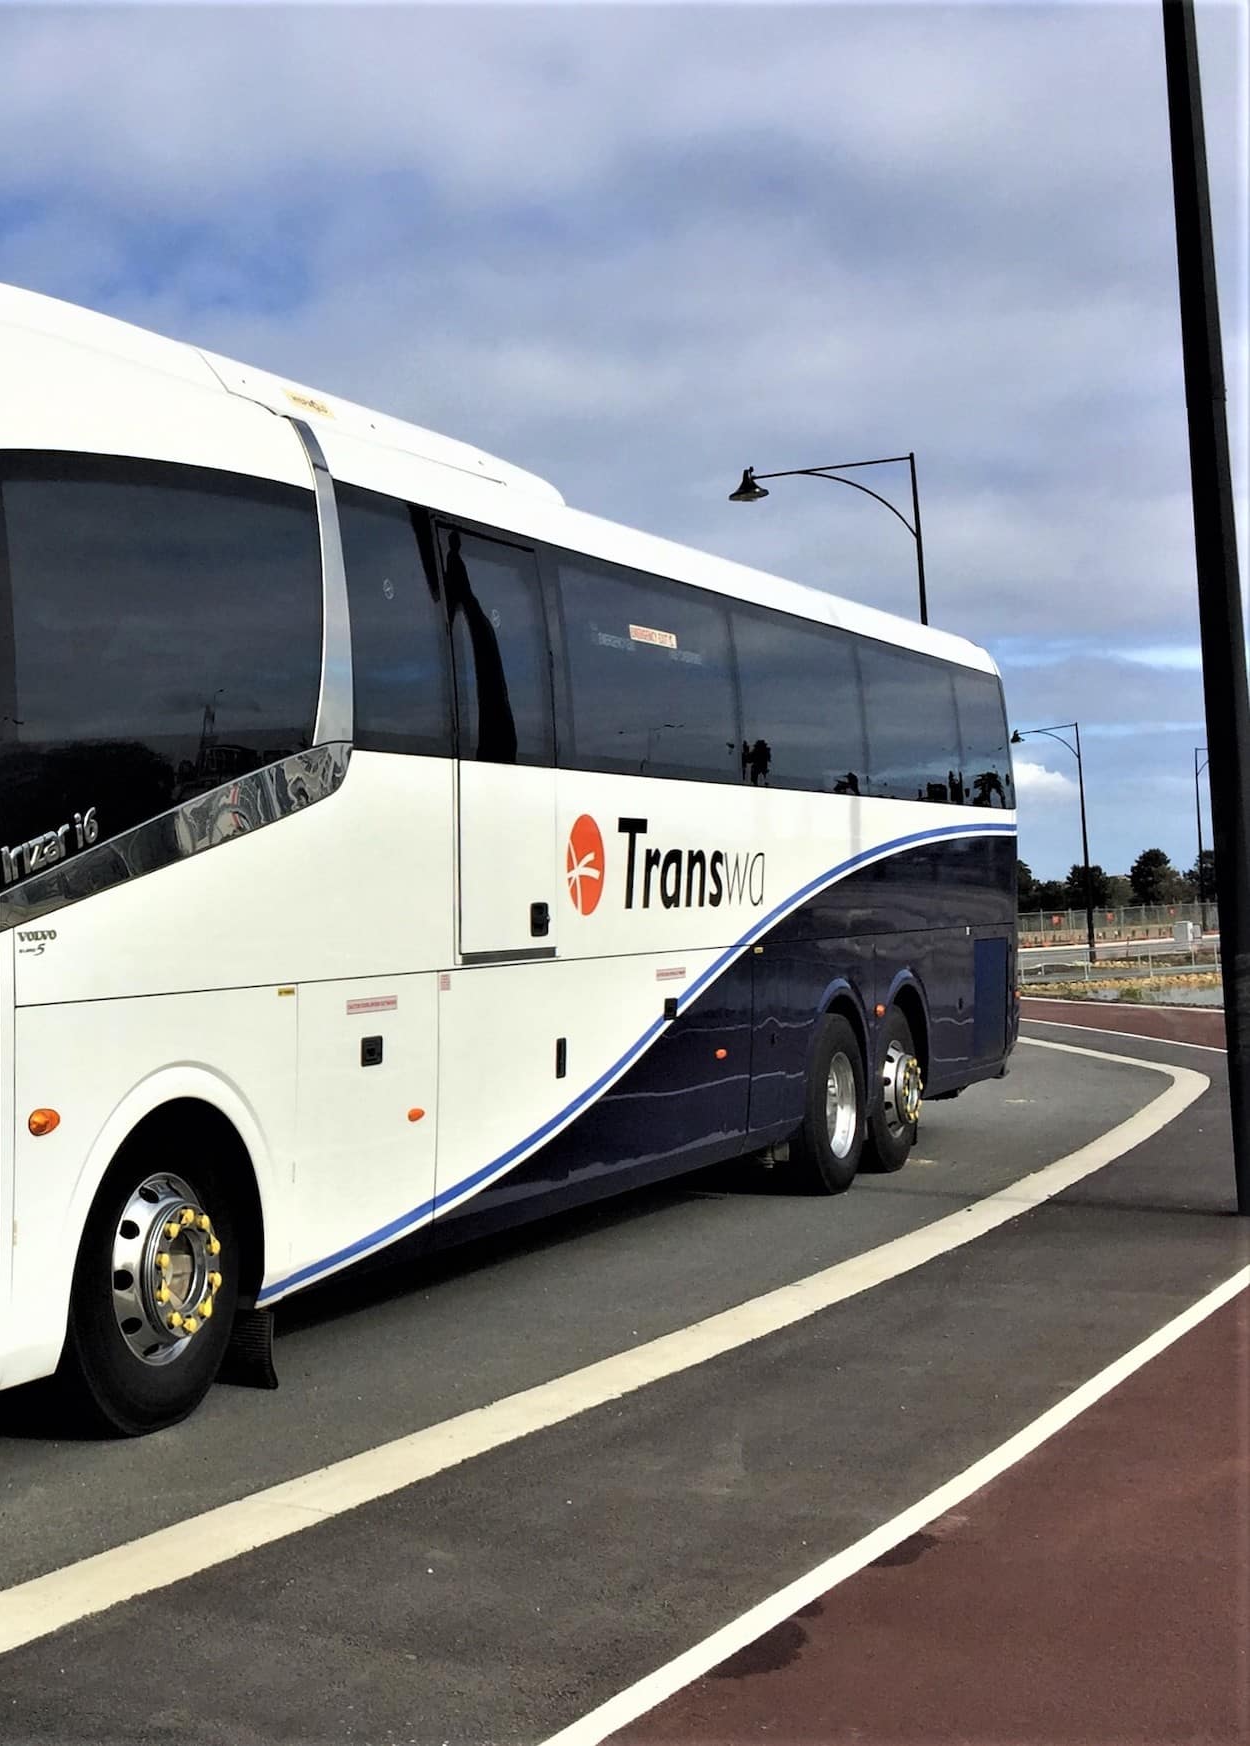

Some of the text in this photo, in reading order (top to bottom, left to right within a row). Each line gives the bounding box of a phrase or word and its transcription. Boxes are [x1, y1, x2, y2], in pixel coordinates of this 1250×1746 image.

[74, 807, 99, 849] i6
[618, 817, 765, 909] Transwa
[17, 930, 57, 942] VOLVO
